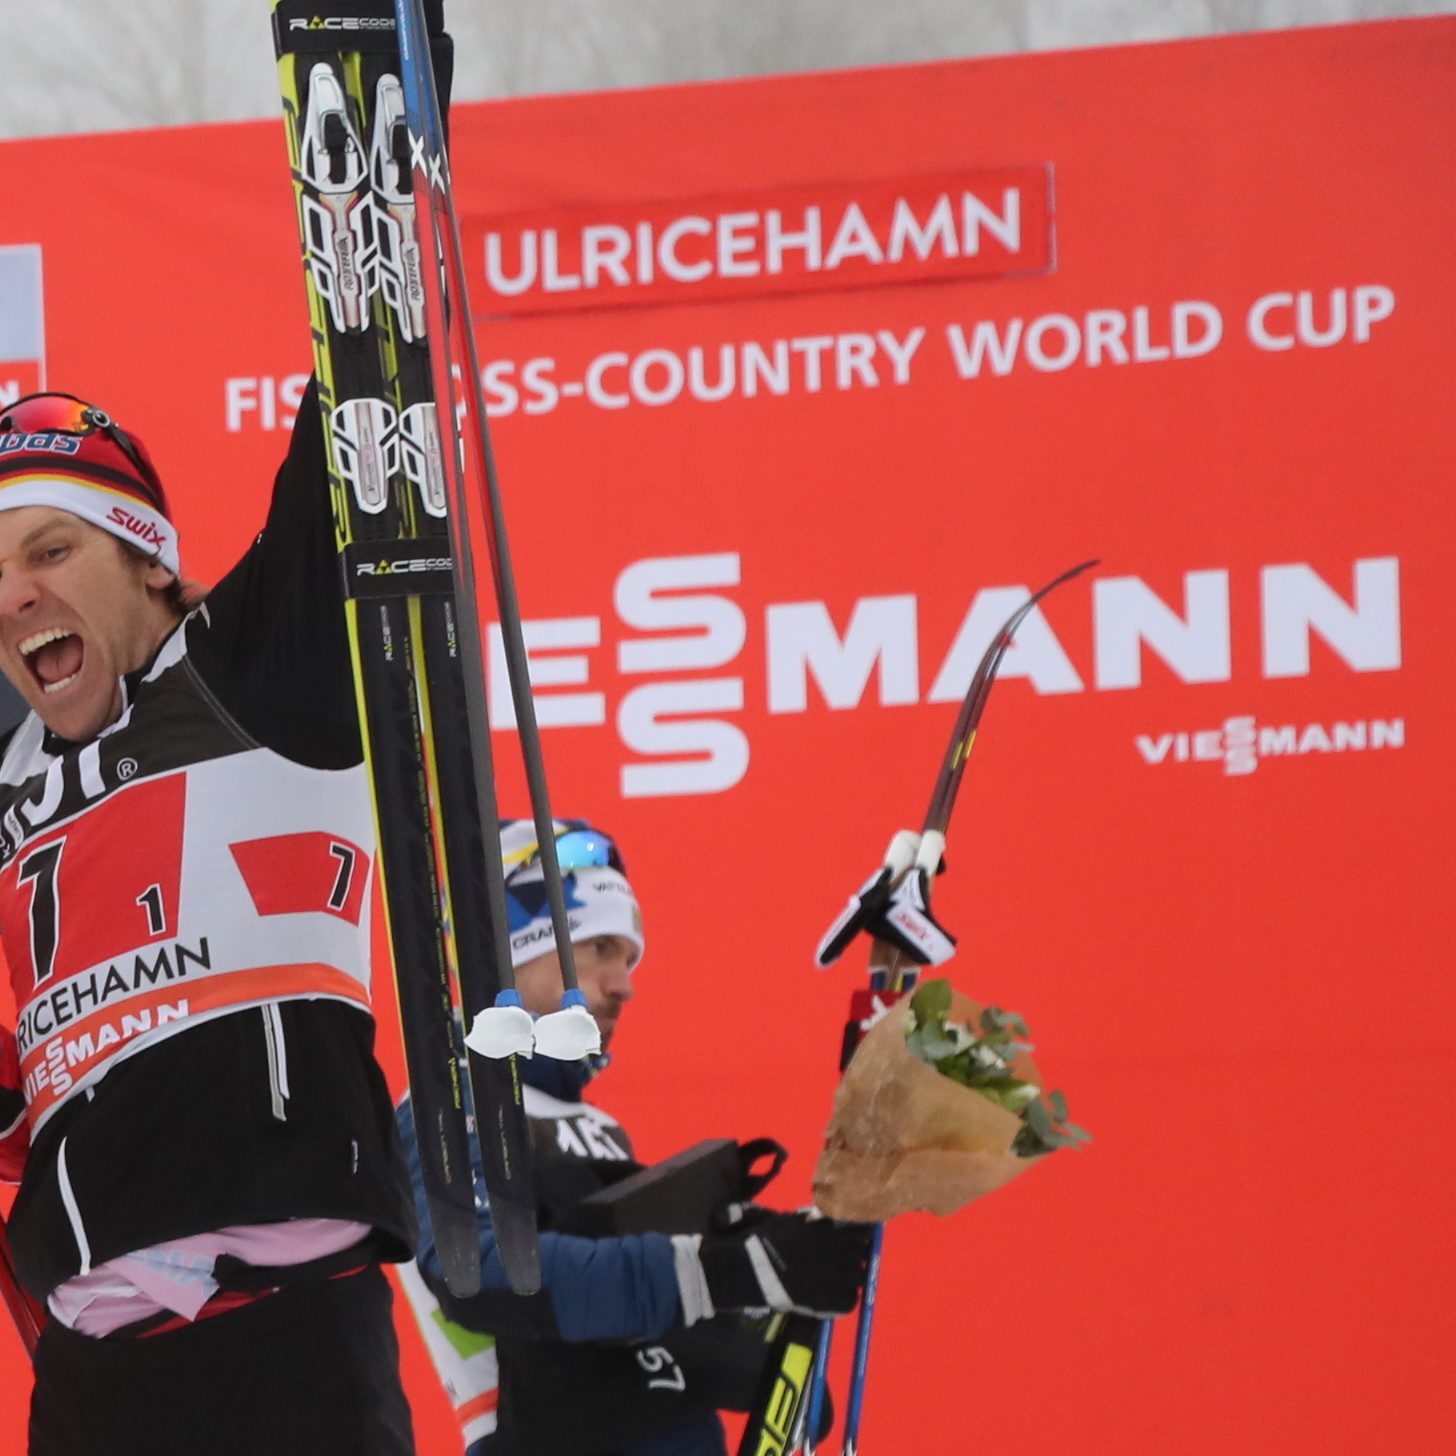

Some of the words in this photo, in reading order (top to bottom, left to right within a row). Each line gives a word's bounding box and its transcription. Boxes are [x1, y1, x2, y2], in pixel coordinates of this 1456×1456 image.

[485, 187, 1021, 296] ULRICEHAMN
[227, 374, 307, 431] FIS
[452, 328, 924, 421] SS-COUNTRY
[945, 301, 1223, 381] WORLD
[1246, 284, 1396, 352] CUP
[489, 549, 1403, 800] ESSMANN
[1135, 713, 1405, 776] VIESSMANN
[136, 882, 167, 936] 1
[327, 841, 356, 911] 7
[17, 937, 212, 1056] RICEHAMN
